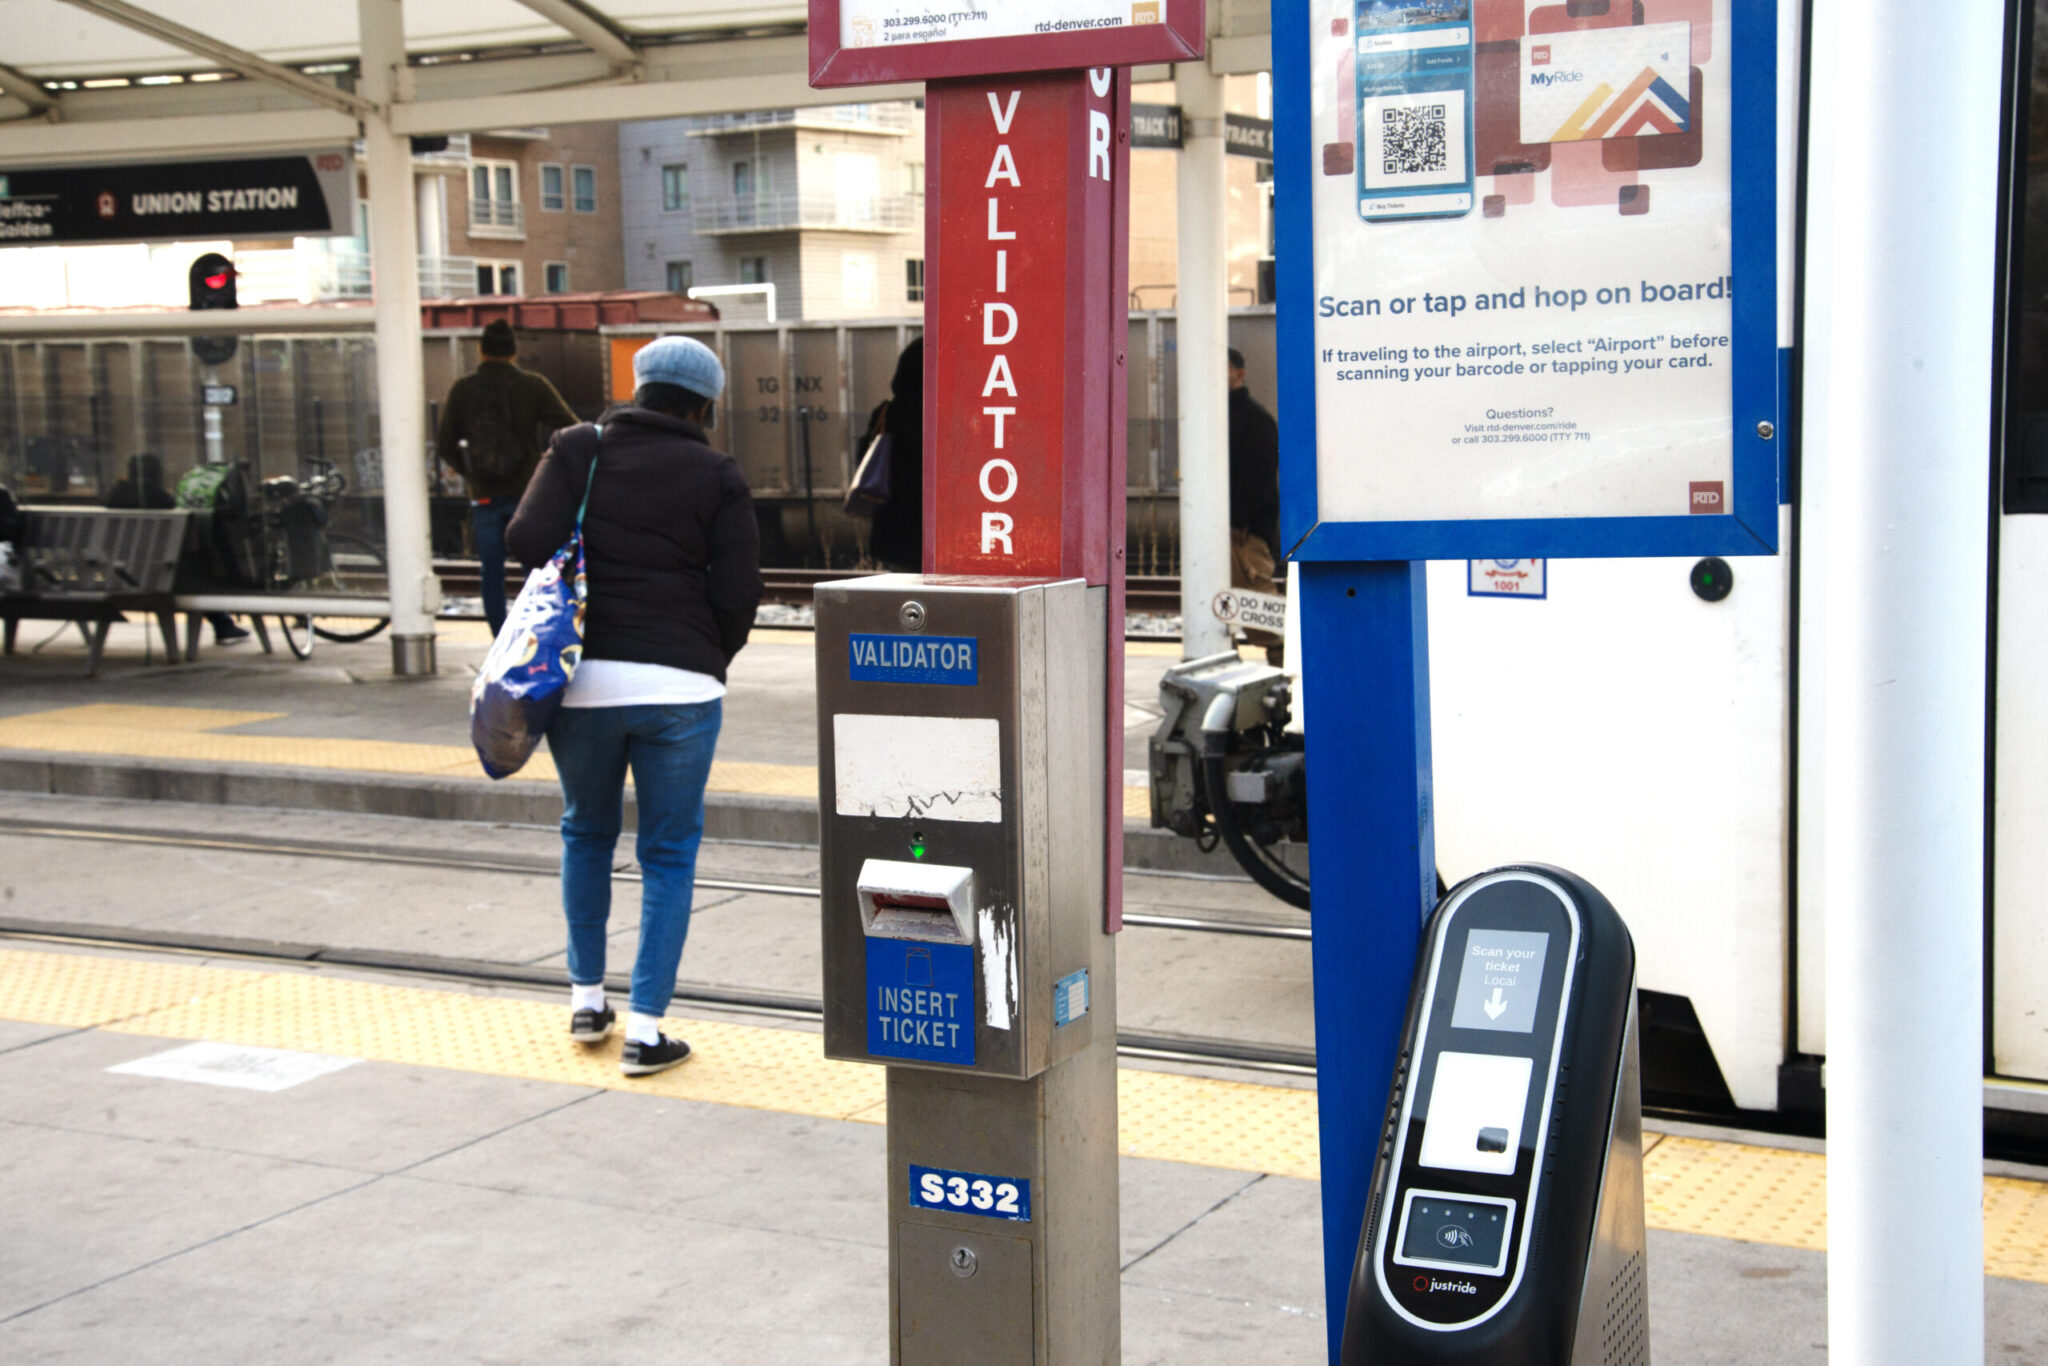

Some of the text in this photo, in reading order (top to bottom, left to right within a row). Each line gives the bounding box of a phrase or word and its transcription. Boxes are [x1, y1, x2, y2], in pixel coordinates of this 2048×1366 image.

[883, 14, 946, 28] 303.299.6000
[1034, 16, 1123, 33] rtd-denver.com
[883, 27, 947, 42] 2 para español
[1530, 70, 1584, 87] MyRide
[1133, 116, 1166, 137] TRACK
[1225, 124, 1265, 148] TRACK
[132, 187, 298, 215] UNION STATION
[1318, 276, 1733, 317] Scan or tap and hop on board!
[979, 90, 1022, 555] VALIDATOR
[1322, 349, 1333, 362] If
[1337, 347, 1408, 363] traveling
[1413, 347, 1429, 360] to
[1434, 345, 1461, 359] the
[1466, 342, 1526, 359] airport,
[1531, 340, 1582, 355] select
[1670, 334, 1729, 349] before
[1337, 353, 1712, 381] scanning your barcode or tapping your card.
[1486, 406, 1554, 420] Questions?
[1464, 421, 1577, 432] Visit rtd-denver.com/ride
[1463, 436, 1479, 444] call
[1481, 433, 1548, 444] 303.299.6000
[1550, 432, 1571, 442] (TTY
[1494, 580, 1520, 591] 1001
[1240, 596, 1286, 614] DO NOT
[1240, 610, 1284, 628] CROSS
[851, 640, 972, 670] VALIDATOR
[1471, 945, 1536, 960] Scan your
[1485, 961, 1520, 973] ticket
[1484, 974, 1517, 987] Local
[878, 986, 958, 1018] INSERT
[879, 1016, 960, 1048] TICKET
[920, 1173, 1019, 1213] S332
[1429, 1278, 1477, 1295] justride
